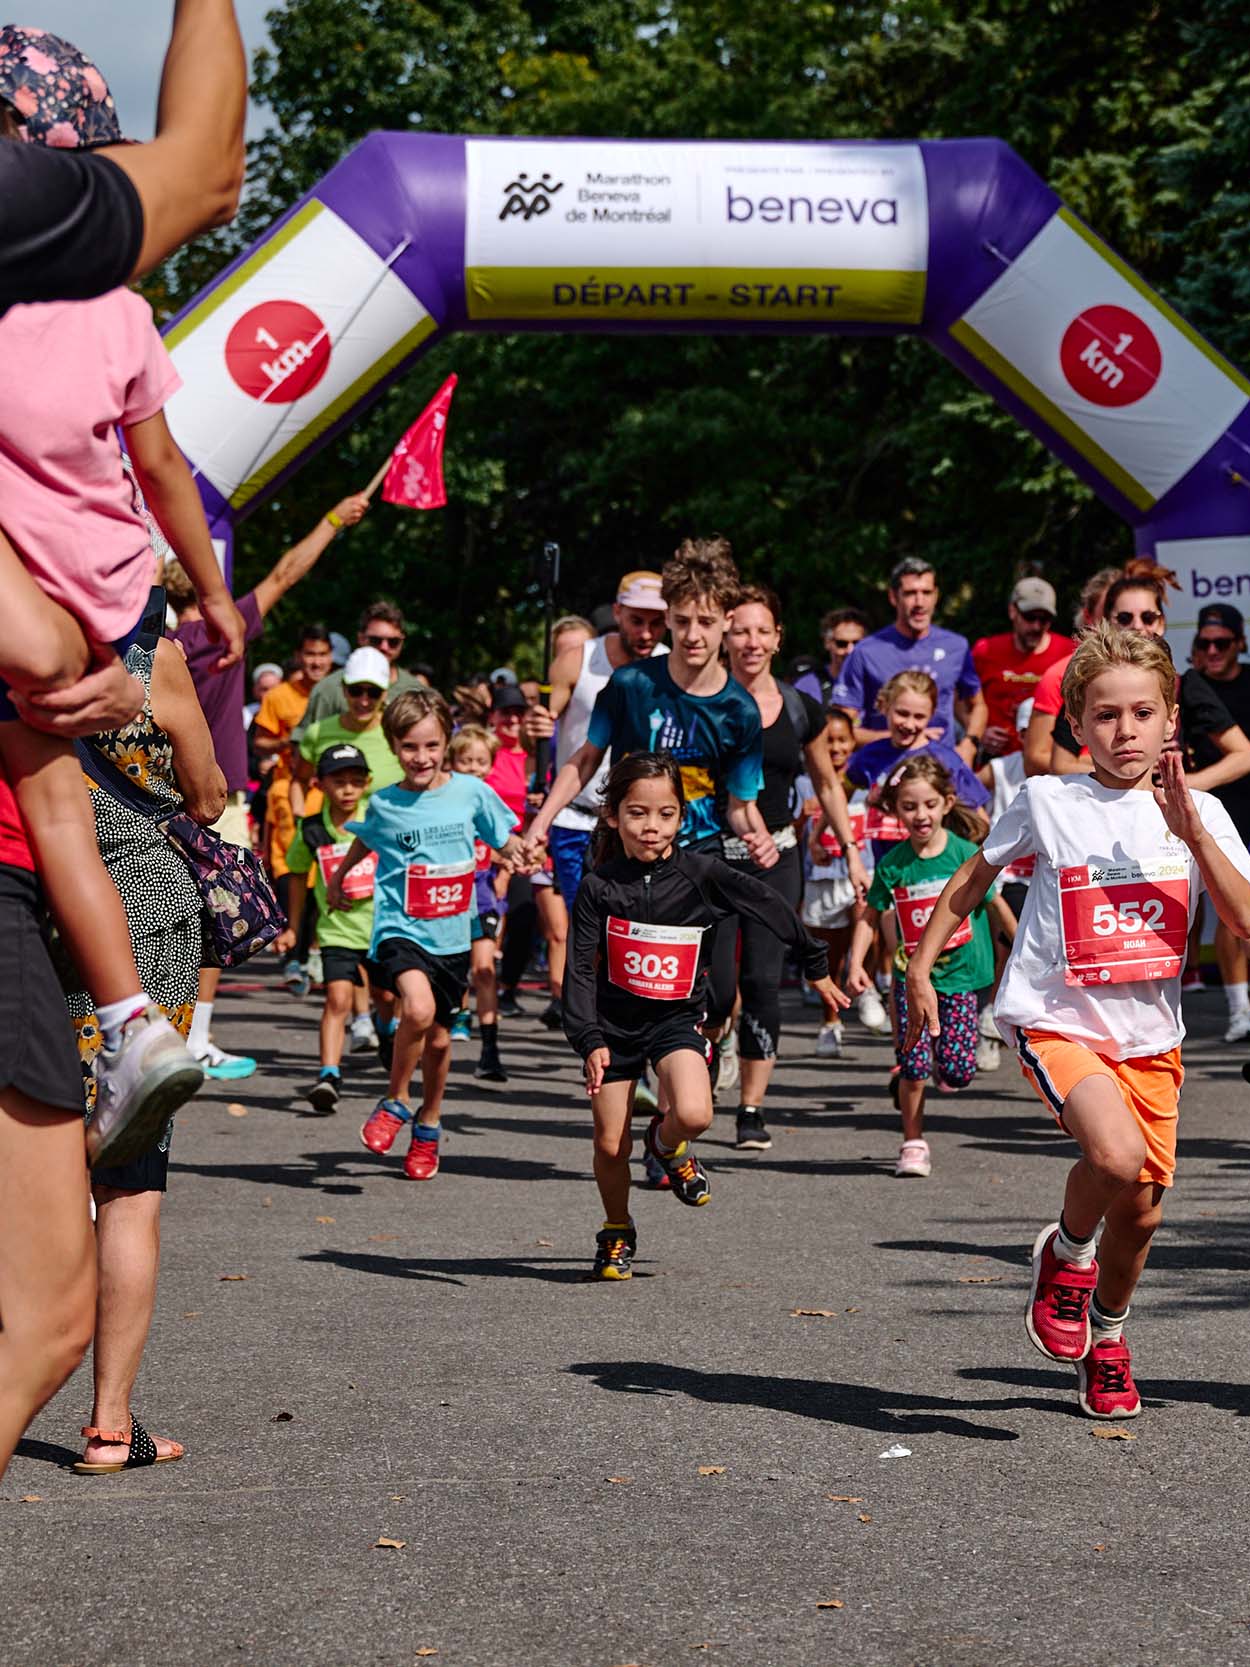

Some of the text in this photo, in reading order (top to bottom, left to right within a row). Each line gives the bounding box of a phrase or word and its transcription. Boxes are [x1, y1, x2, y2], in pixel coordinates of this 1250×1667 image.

[586, 173, 671, 184] Marathon
[578, 189, 640, 201] Beneva
[726, 185, 897, 225] beneva
[565, 207, 671, 223] de Montréal
[553, 275, 694, 306] DÉPART
[729, 284, 841, 307] START
[256, 326, 279, 350] 1
[1114, 333, 1133, 355] 1
[1080, 339, 1124, 389] km
[1158, 865, 1185, 876] 2024
[427, 883, 463, 904] 132
[1092, 899, 1165, 936] 552
[1123, 939, 1147, 950] NOAH
[624, 951, 679, 980] 303
